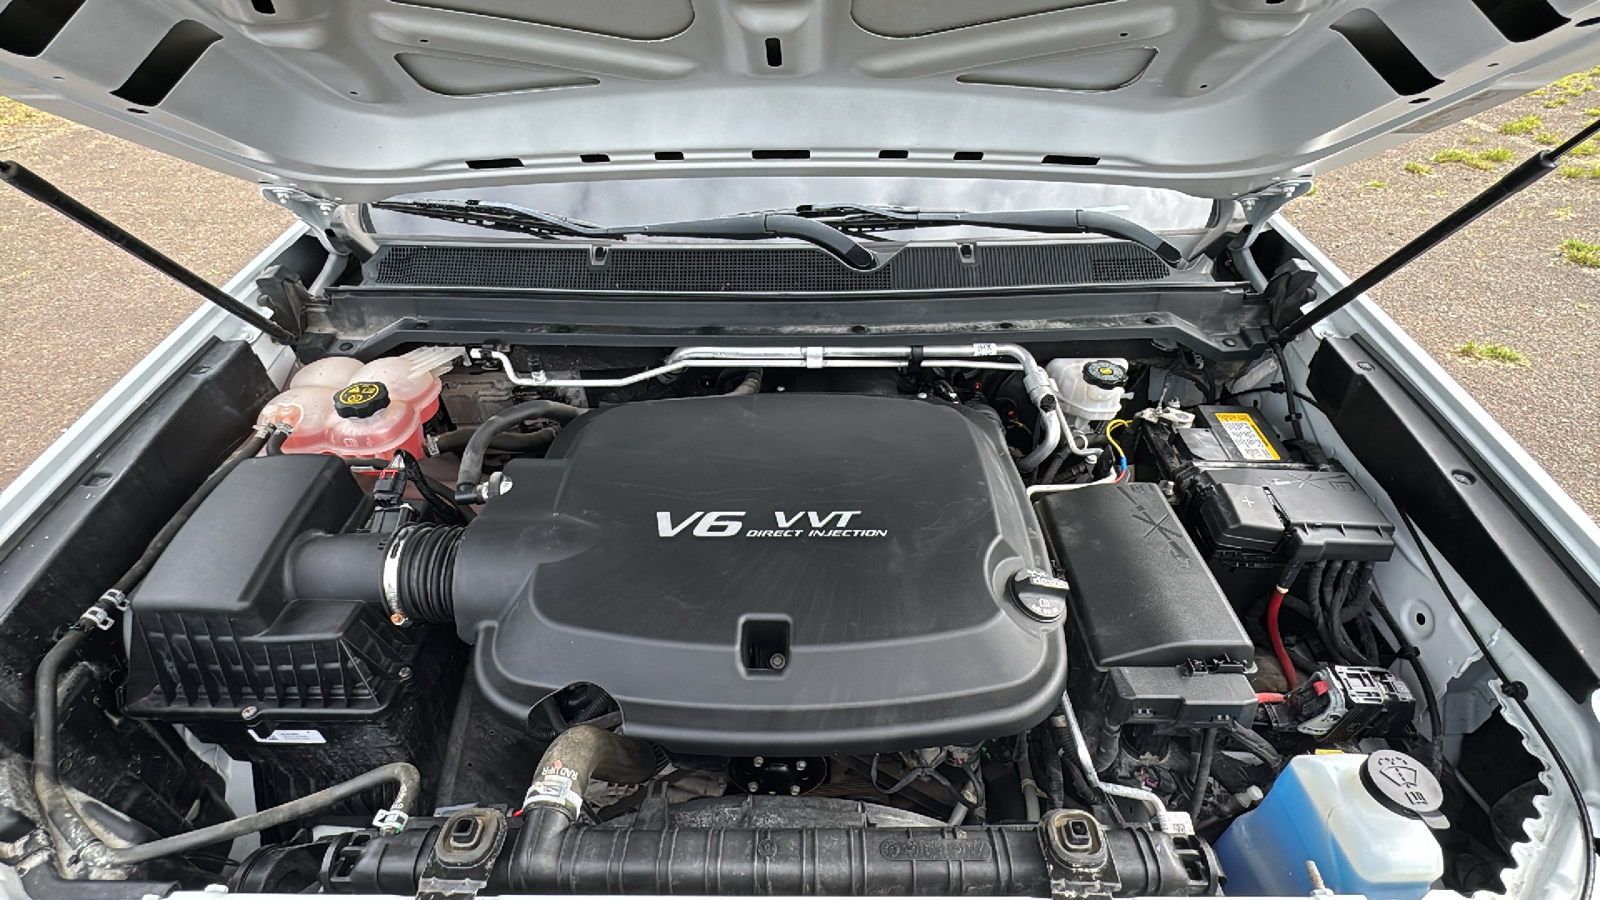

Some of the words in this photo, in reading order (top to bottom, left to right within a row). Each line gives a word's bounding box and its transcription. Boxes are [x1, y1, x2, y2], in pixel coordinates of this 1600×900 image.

[656, 511, 746, 537] V6
[774, 511, 862, 528] VVT
[746, 529, 804, 537] DIRECT
[808, 529, 888, 537] INJECTION
[560, 768, 579, 780] RAD
